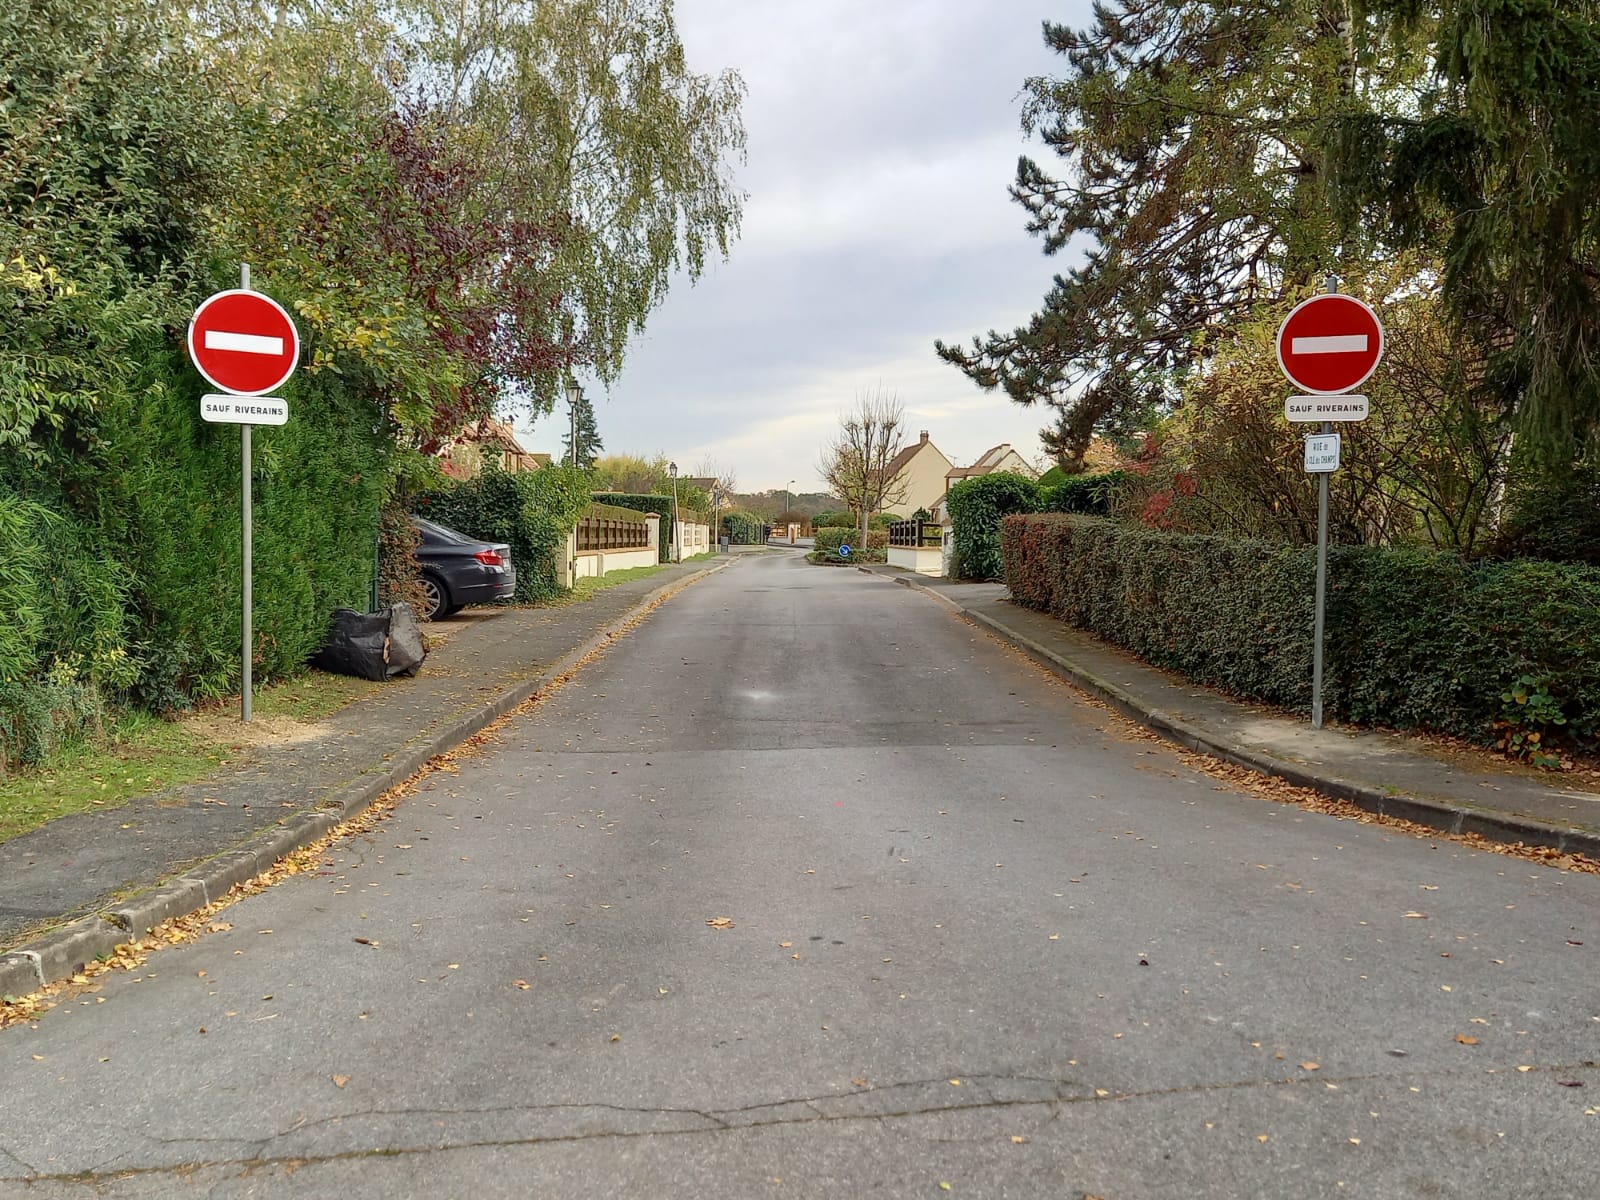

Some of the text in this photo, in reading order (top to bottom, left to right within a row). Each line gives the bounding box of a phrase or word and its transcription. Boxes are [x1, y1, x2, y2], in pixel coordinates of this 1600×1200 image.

[206, 404, 284, 416] SAUF RIVERAINS
[1289, 404, 1364, 413] SAUF RIVERAINS
